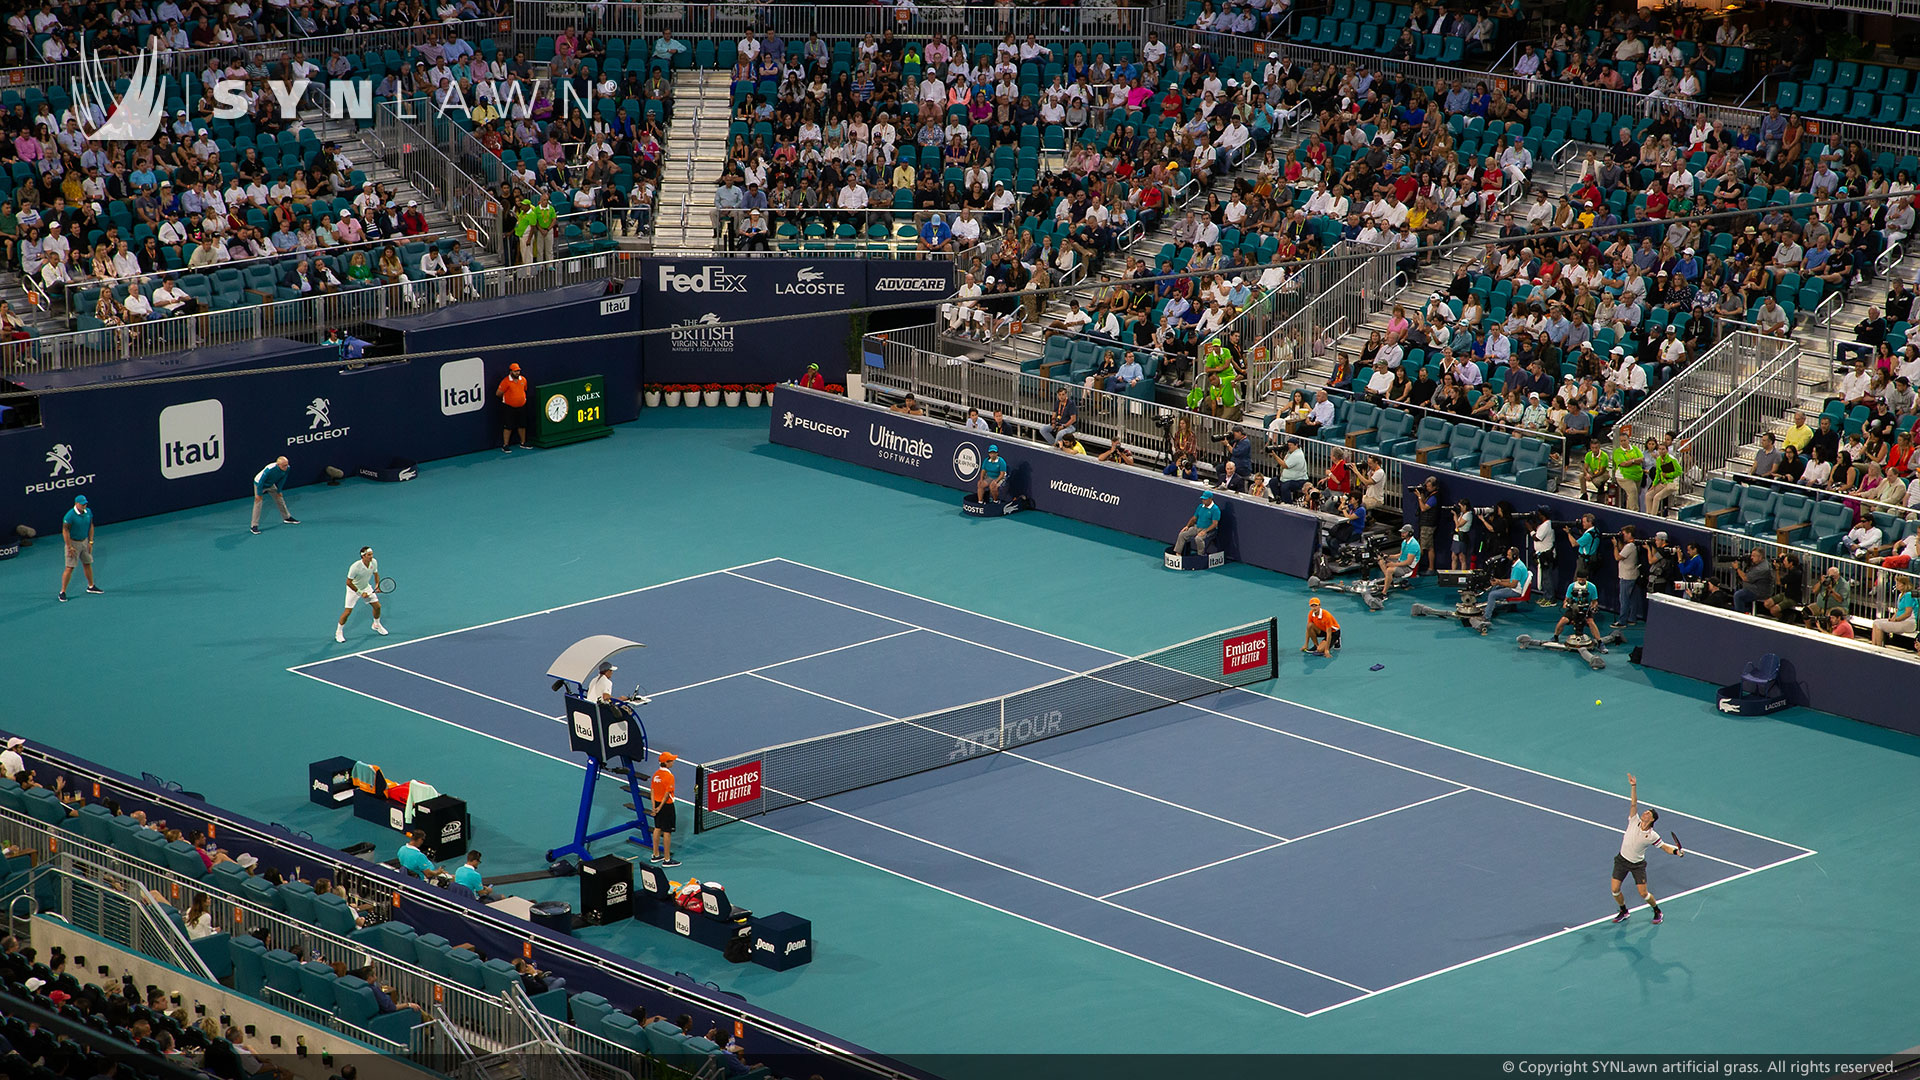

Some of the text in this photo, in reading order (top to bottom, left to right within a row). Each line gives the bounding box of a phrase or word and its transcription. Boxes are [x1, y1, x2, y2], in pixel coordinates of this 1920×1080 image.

[659, 265, 748, 293] FedEx
[875, 278, 946, 291] ADVOCARE
[775, 283, 845, 295] LACOSTE
[605, 299, 626, 313] Itaú
[671, 324, 734, 340] BRITISH
[444, 384, 482, 408] Itaú
[576, 391, 601, 402] ROLEX
[577, 405, 600, 423] 0:21
[287, 426, 350, 446] PEUGEOT
[794, 417, 850, 439] PEUGEOT
[869, 423, 933, 460] Ultimate
[165, 435, 220, 468] Itaú
[878, 450, 921, 467] SOFTWARE
[360, 469, 378, 478] LACOSTE
[25, 473, 96, 495] PEUGEOT
[1050, 479, 1121, 506] wtatennis.com
[1209, 555, 1224, 567] Itaú
[1225, 638, 1266, 658] Emirates
[1231, 650, 1260, 668] FLY BETTER
[1764, 699, 1787, 711] LACOSTE
[576, 723, 592, 737] Itaú
[609, 732, 627, 744] Itaú
[946, 710, 1063, 760] ATP TOUR
[710, 771, 759, 793] Emirates
[717, 784, 752, 804] FLY BETTER
[391, 815, 402, 827] Itaú
[644, 879, 656, 890] Itaú
[704, 901, 718, 912] Itaú
[676, 922, 689, 933] Itaú
